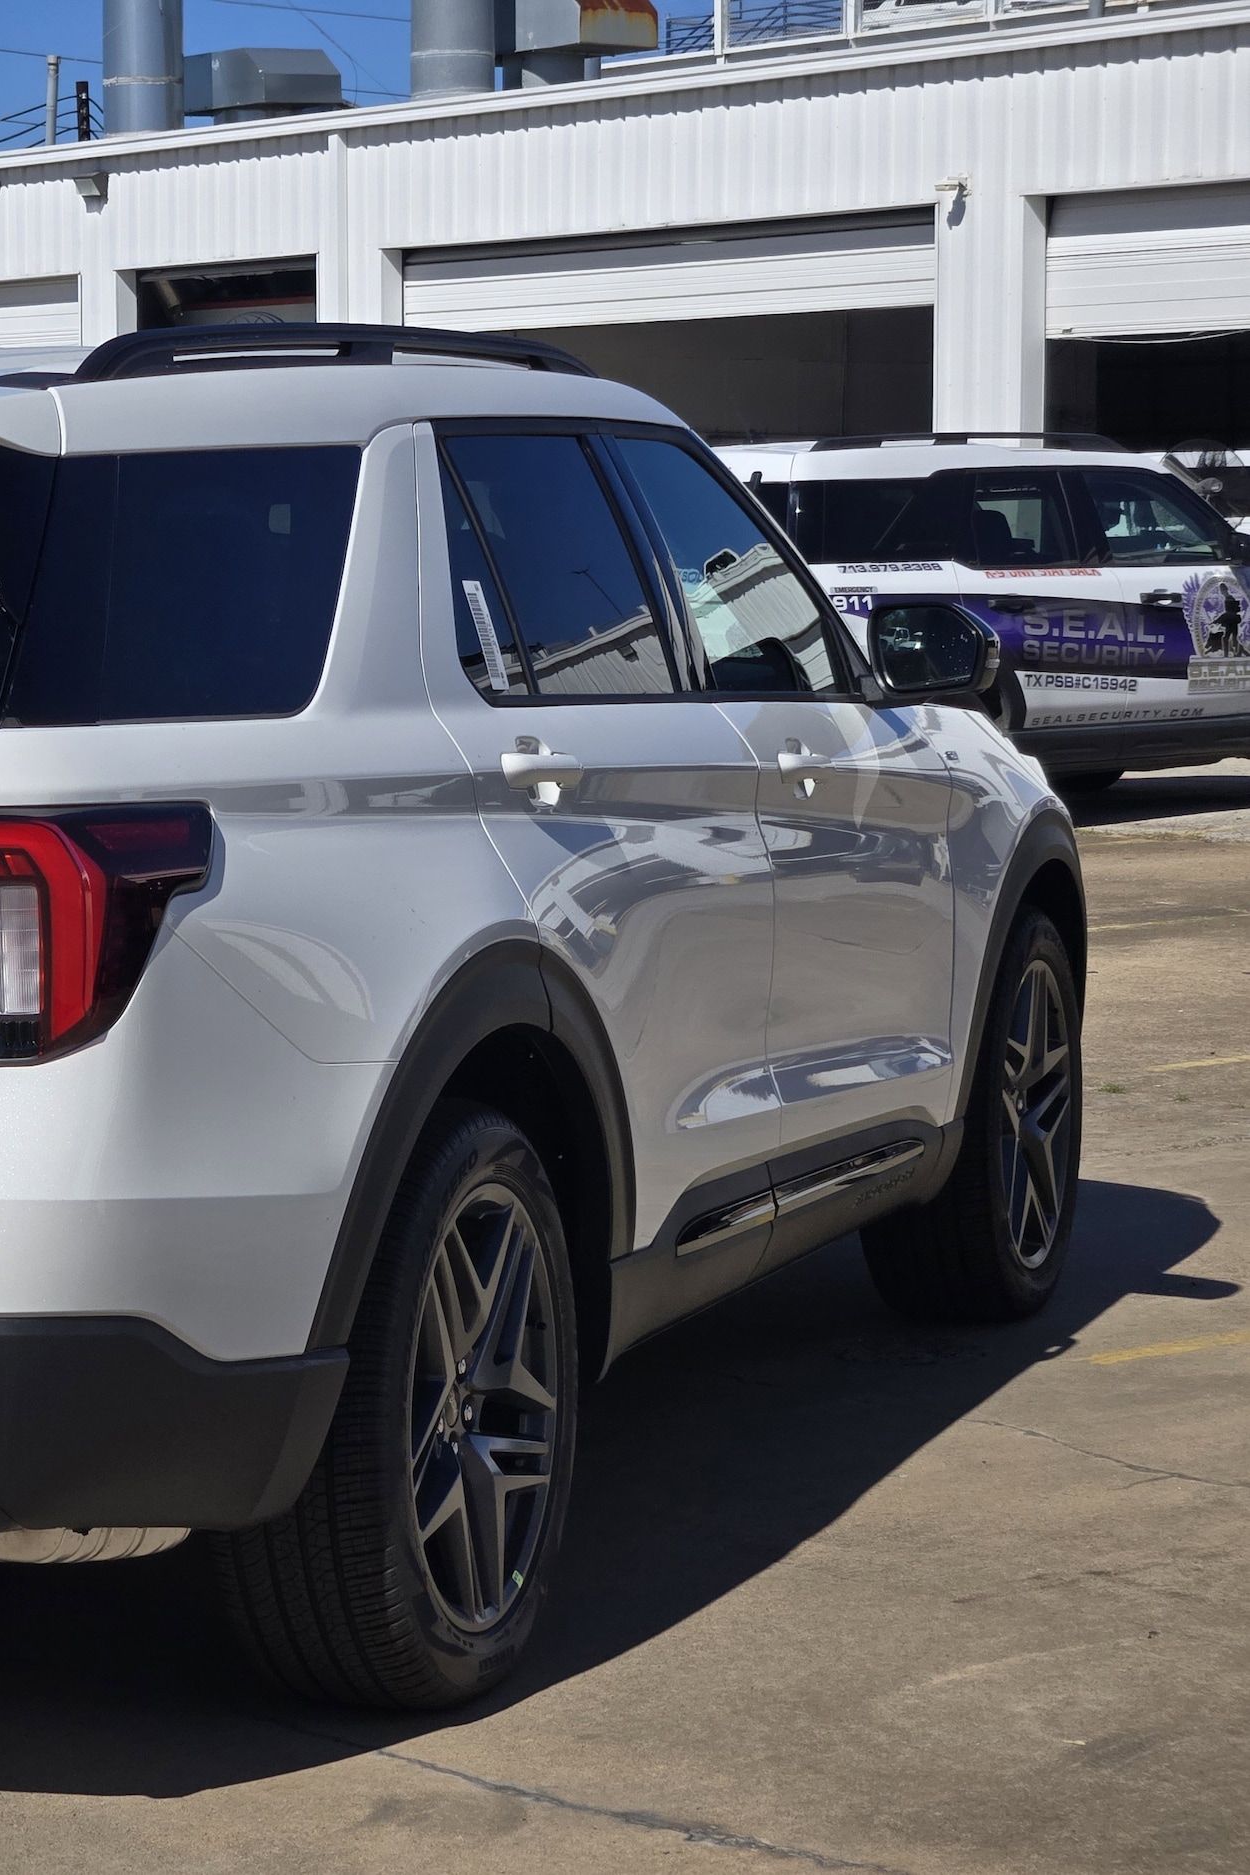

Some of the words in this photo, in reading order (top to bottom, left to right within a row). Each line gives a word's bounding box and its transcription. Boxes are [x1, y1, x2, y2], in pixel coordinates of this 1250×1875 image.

[837, 563, 943, 574] 713.979.2388
[831, 595, 873, 612] 911
[1023, 608, 1165, 644] S.E.A.L.
[1023, 639, 1165, 667] SECURITY
[1024, 674, 1042, 687] TX
[1045, 675, 1137, 692] PSB#C15942
[1031, 708, 1204, 726] SEALSECURITY.COM
